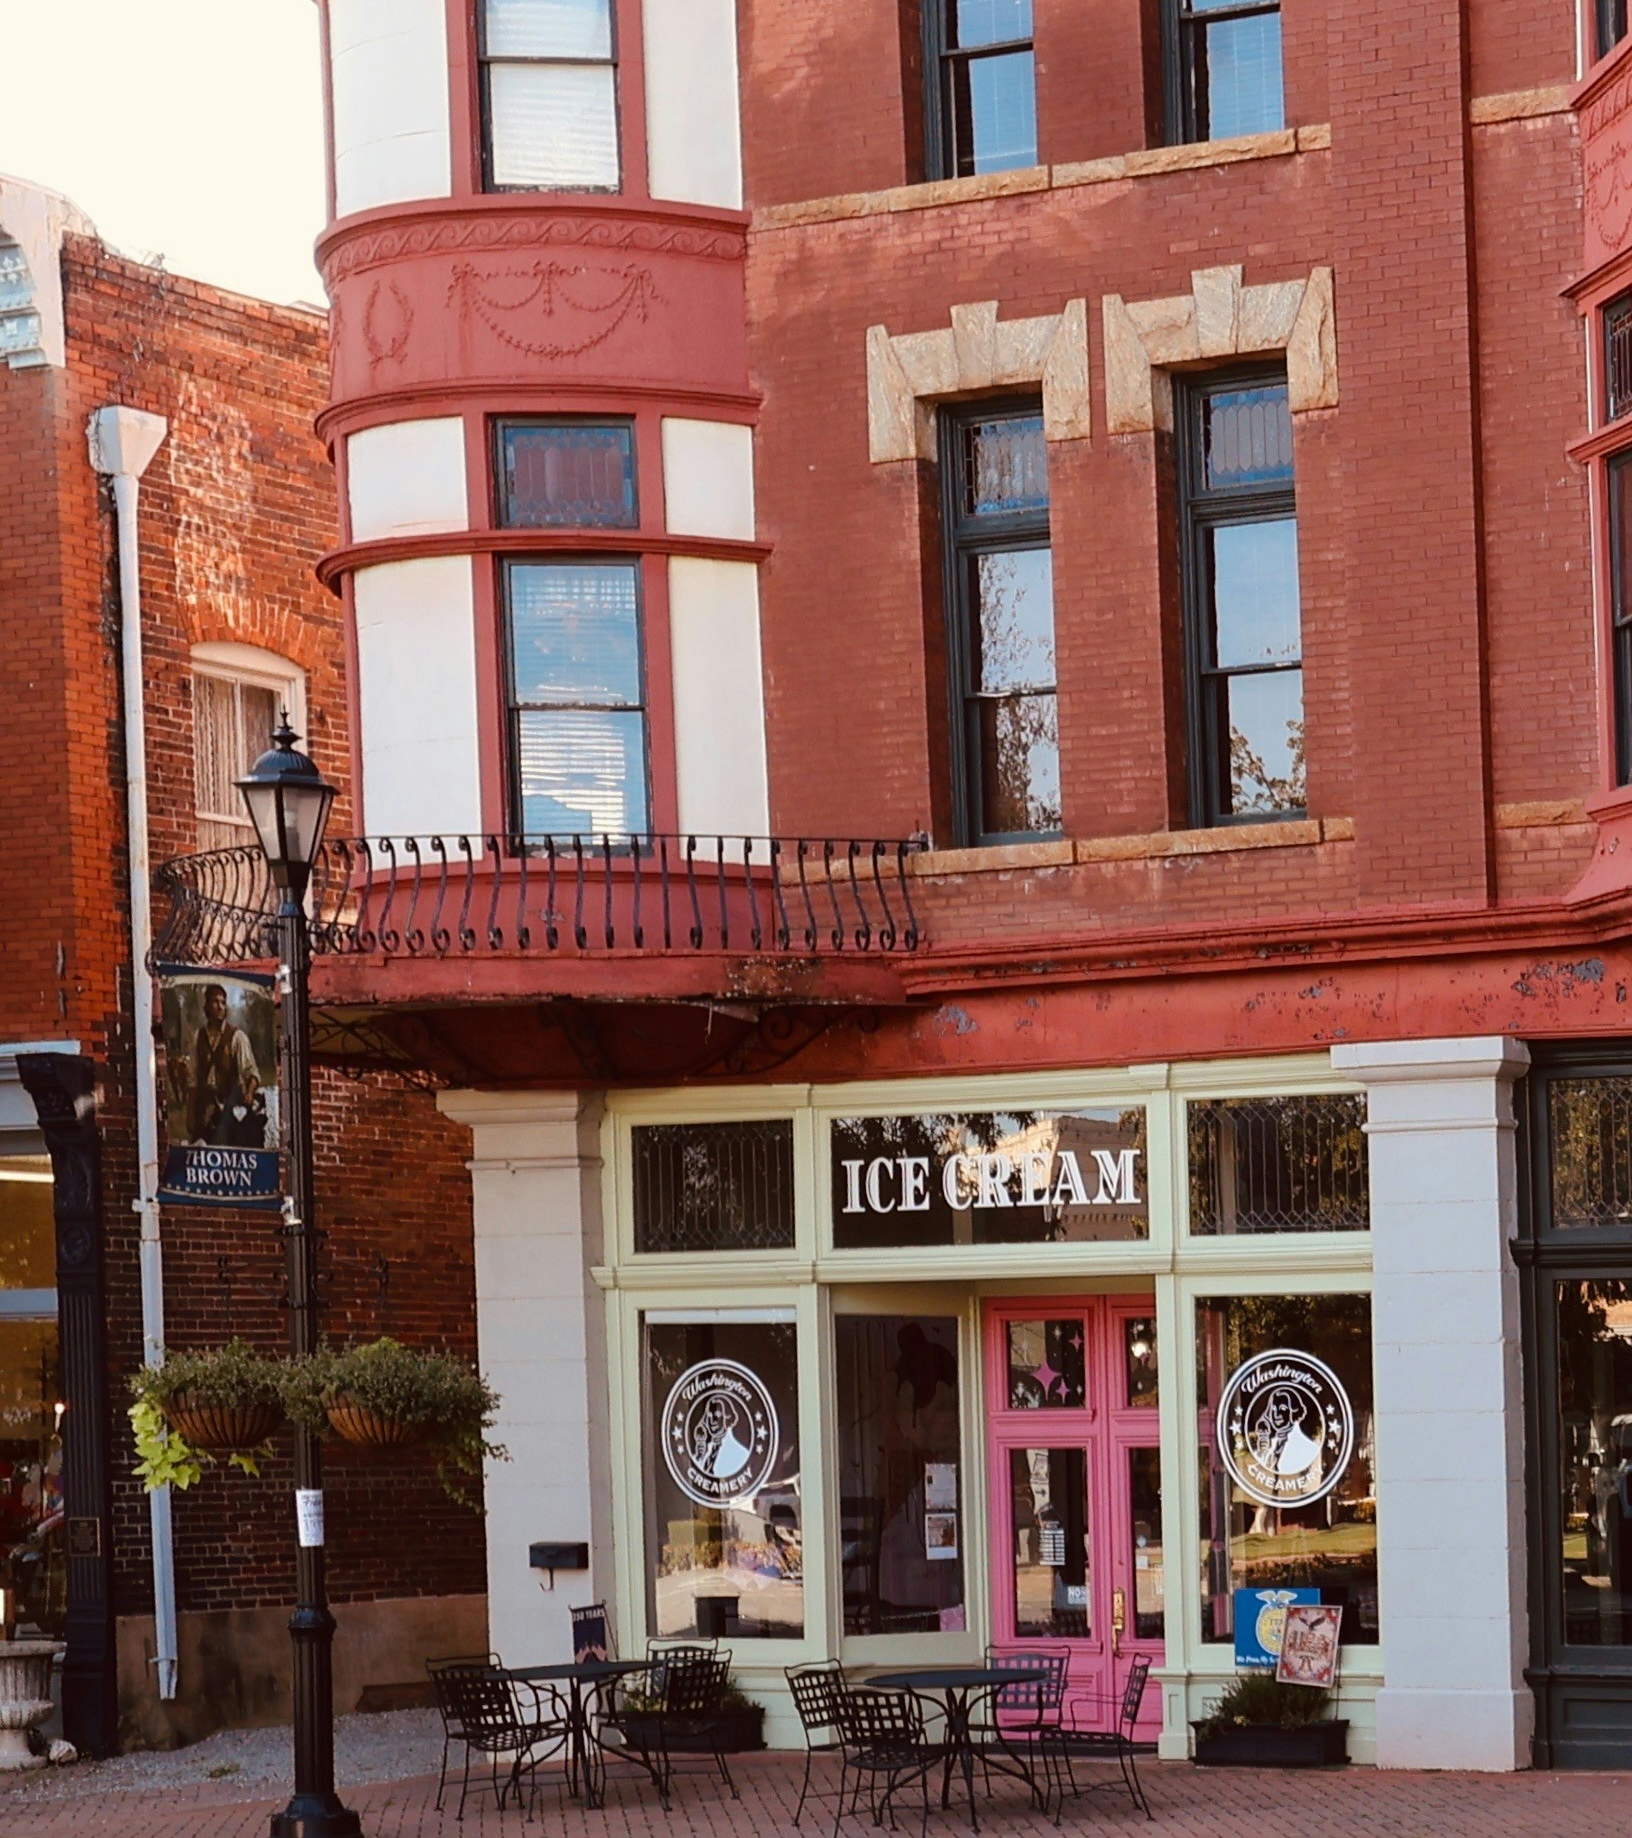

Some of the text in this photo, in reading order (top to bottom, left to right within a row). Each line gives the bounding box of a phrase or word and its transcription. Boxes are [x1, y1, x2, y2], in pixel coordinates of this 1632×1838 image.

[185, 1149, 258, 1170] THOMAS
[185, 1167, 252, 1187] BROWN
[841, 1148, 1141, 1213] ICE CREAM
[682, 1372, 753, 1402] Washington
[1241, 1364, 1324, 1395] Washington
[687, 1465, 754, 1494] CREAMERY
[1247, 1462, 1324, 1492] CREAMERY
